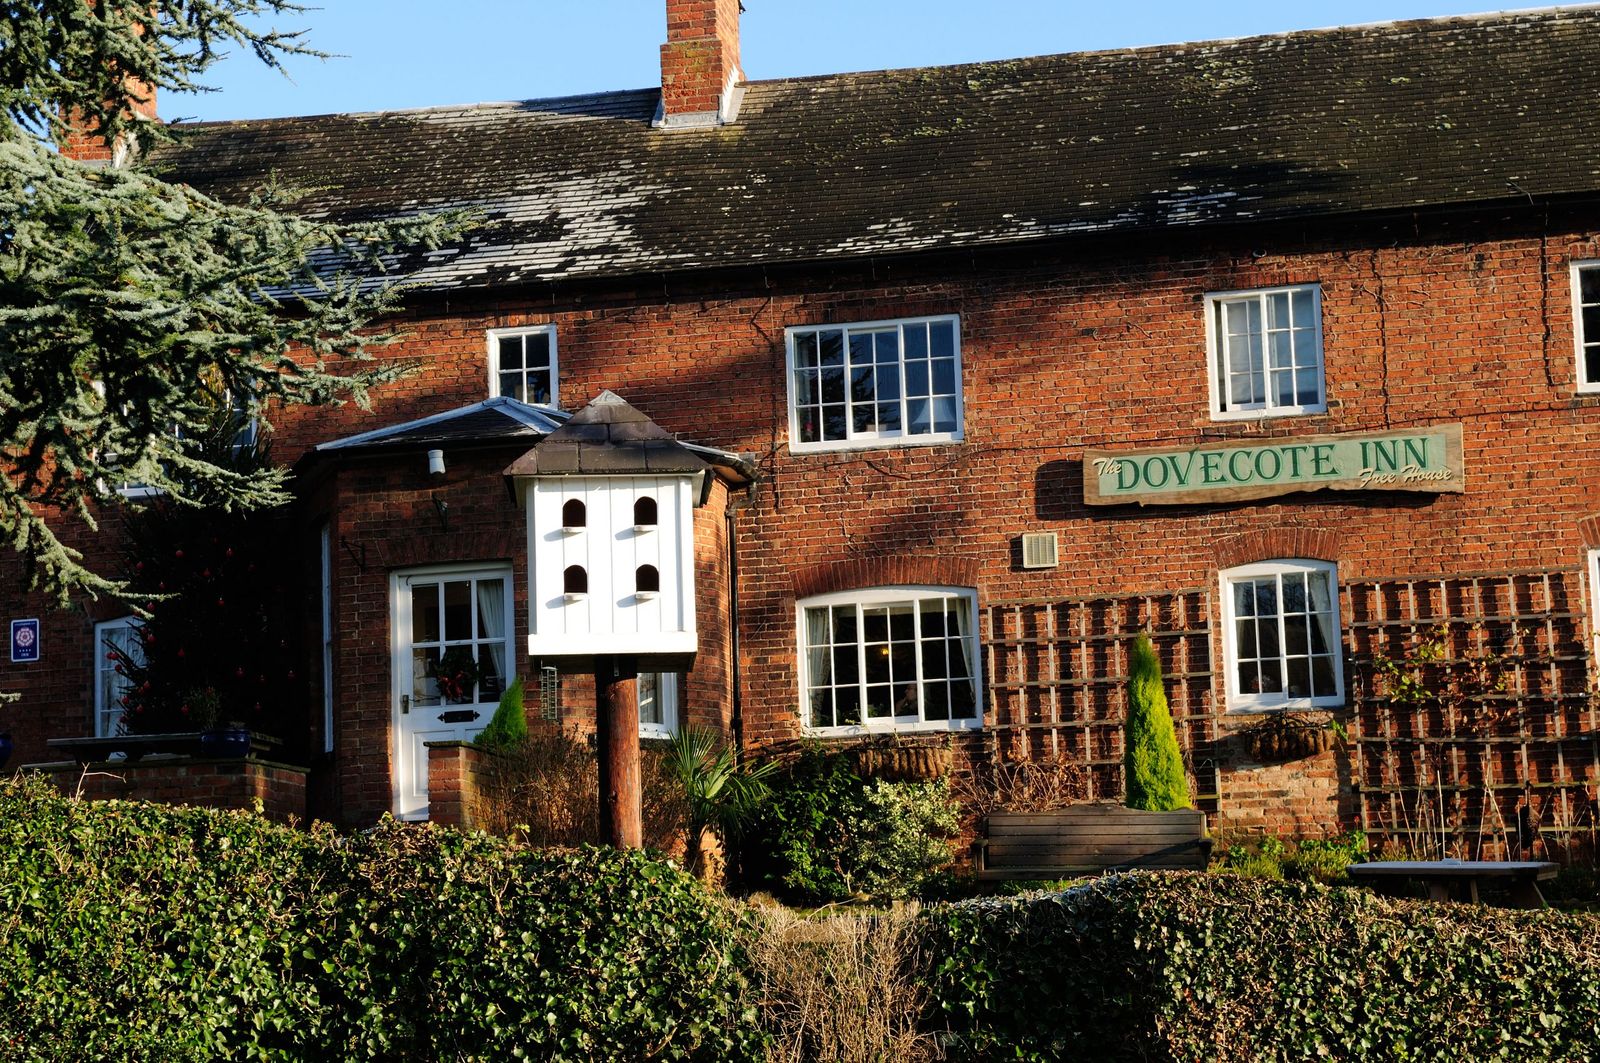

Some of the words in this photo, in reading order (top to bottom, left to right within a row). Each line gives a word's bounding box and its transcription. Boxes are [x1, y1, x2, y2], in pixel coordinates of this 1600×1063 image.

[1092, 457, 1122, 477] The
[1116, 444, 1339, 489] DOVECOTE
[1359, 437, 1429, 472] INN
[1358, 467, 1397, 488] Free
[1402, 464, 1452, 483] House
